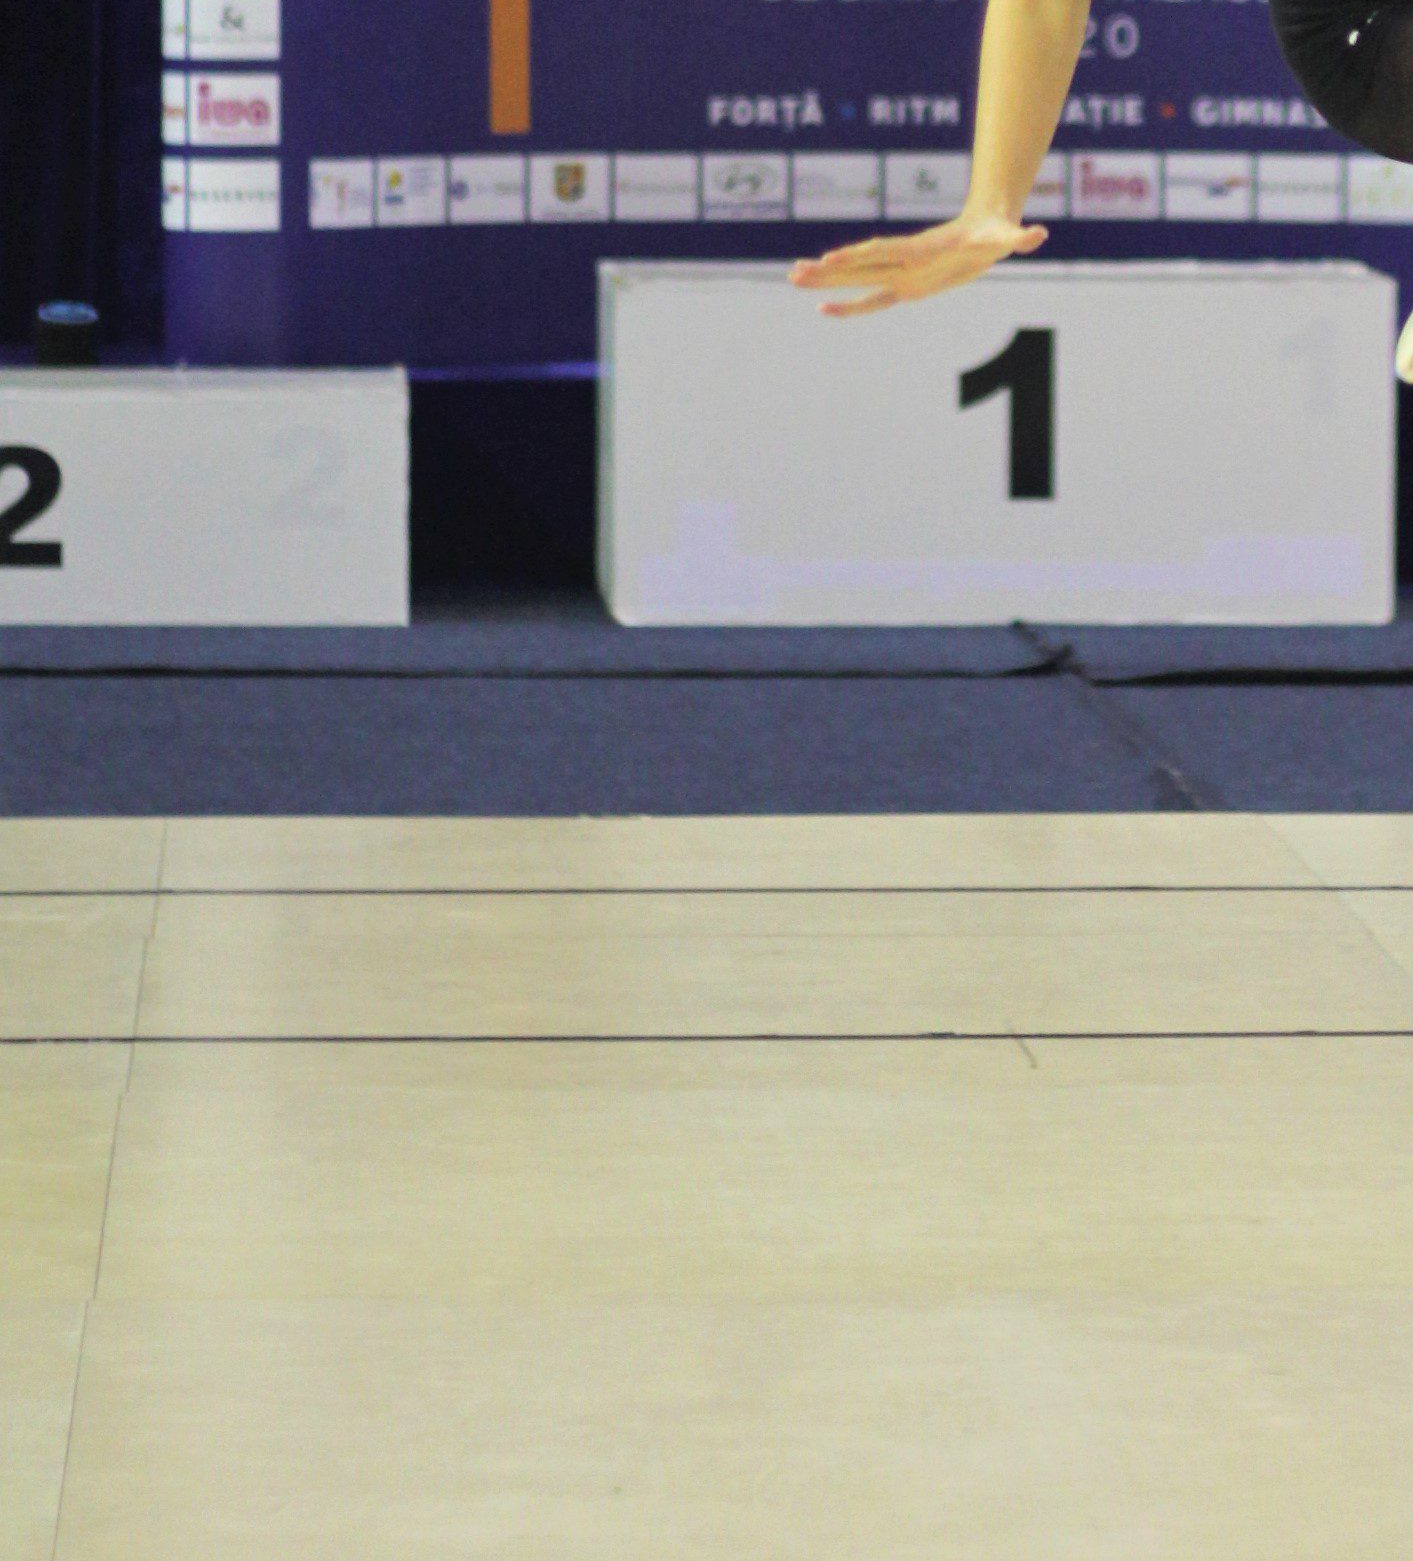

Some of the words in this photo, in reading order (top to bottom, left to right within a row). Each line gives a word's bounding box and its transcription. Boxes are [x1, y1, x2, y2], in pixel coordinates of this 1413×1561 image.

[867, 93, 962, 127] RITM
[1060, 91, 1146, 130] AȚIE
[957, 326, 1058, 500] 1
[0, 444, 64, 568] 2
